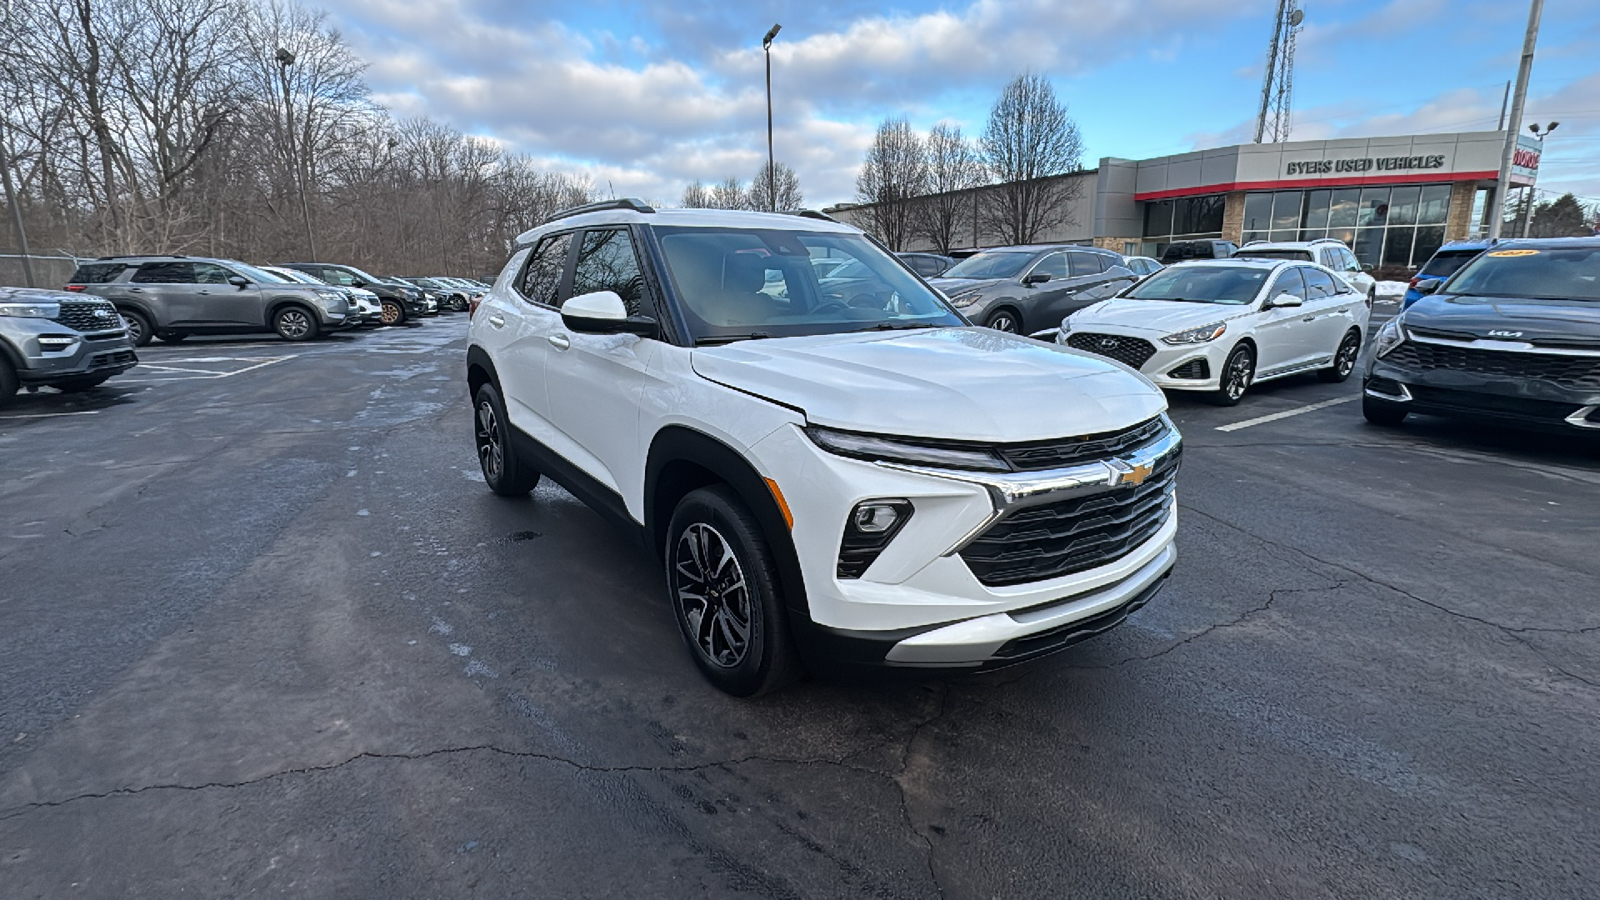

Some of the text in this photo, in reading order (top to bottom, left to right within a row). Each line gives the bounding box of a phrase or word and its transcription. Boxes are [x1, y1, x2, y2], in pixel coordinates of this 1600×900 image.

[1287, 155, 1445, 175] BYERS USED VEHICLES
